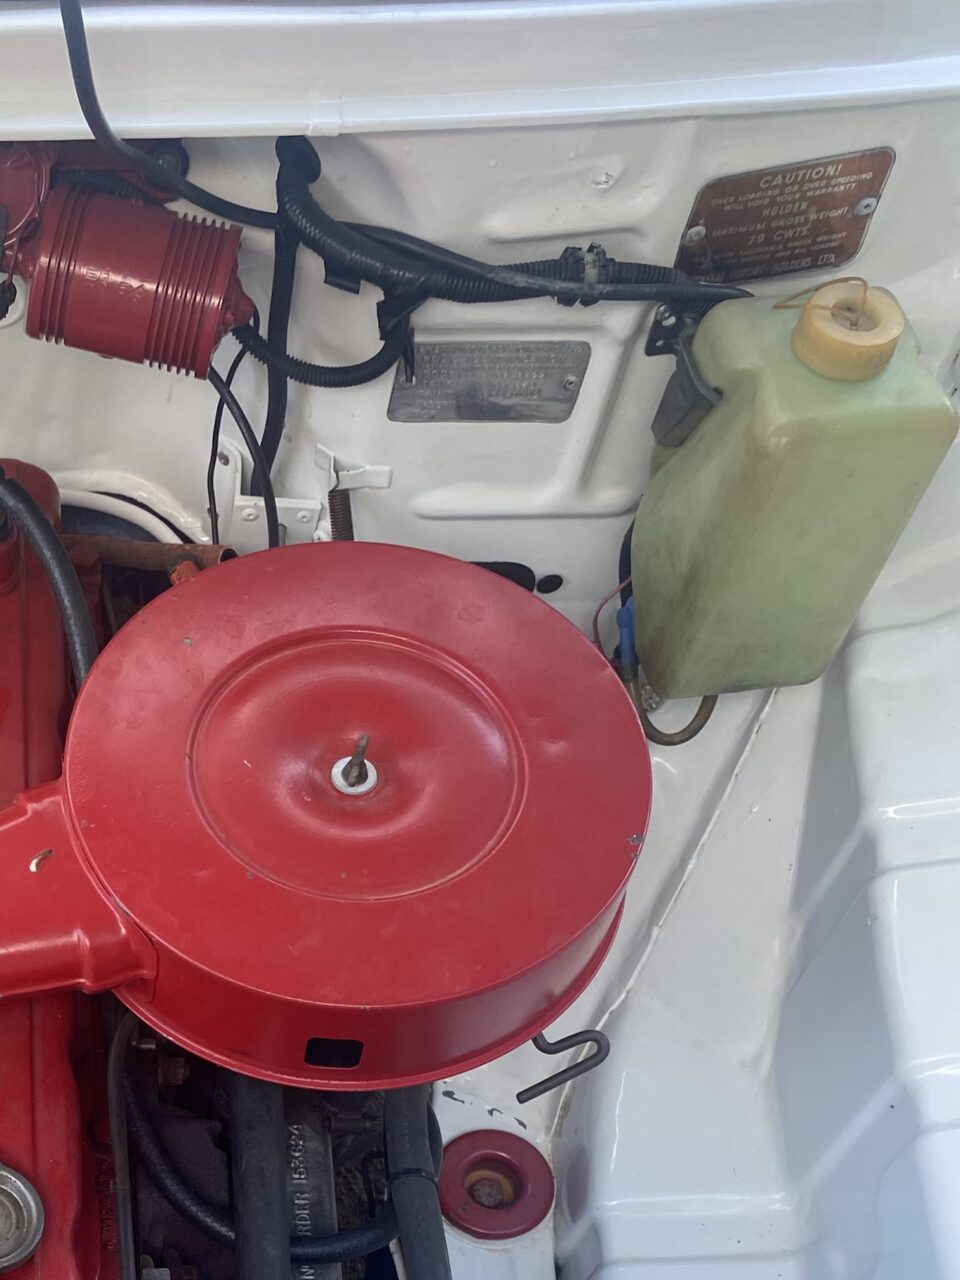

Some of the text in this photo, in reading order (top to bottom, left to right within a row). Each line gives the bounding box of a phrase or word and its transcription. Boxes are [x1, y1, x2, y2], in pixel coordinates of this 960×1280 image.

[738, 187, 781, 202] LOADING
[784, 183, 799, 194] OR
[802, 179, 828, 192] OVER
[830, 170, 873, 186] SPEEDING
[760, 163, 842, 188] CAUTION!
[776, 192, 801, 205] YOUR
[806, 182, 858, 199] WARRANTY
[762, 200, 809, 218] HOLDEN
[711, 222, 767, 238] MAXIMUM
[771, 214, 807, 228] GROSS
[288, 1123, 308, 1185] 153624
[293, 1192, 312, 1236] RDER
